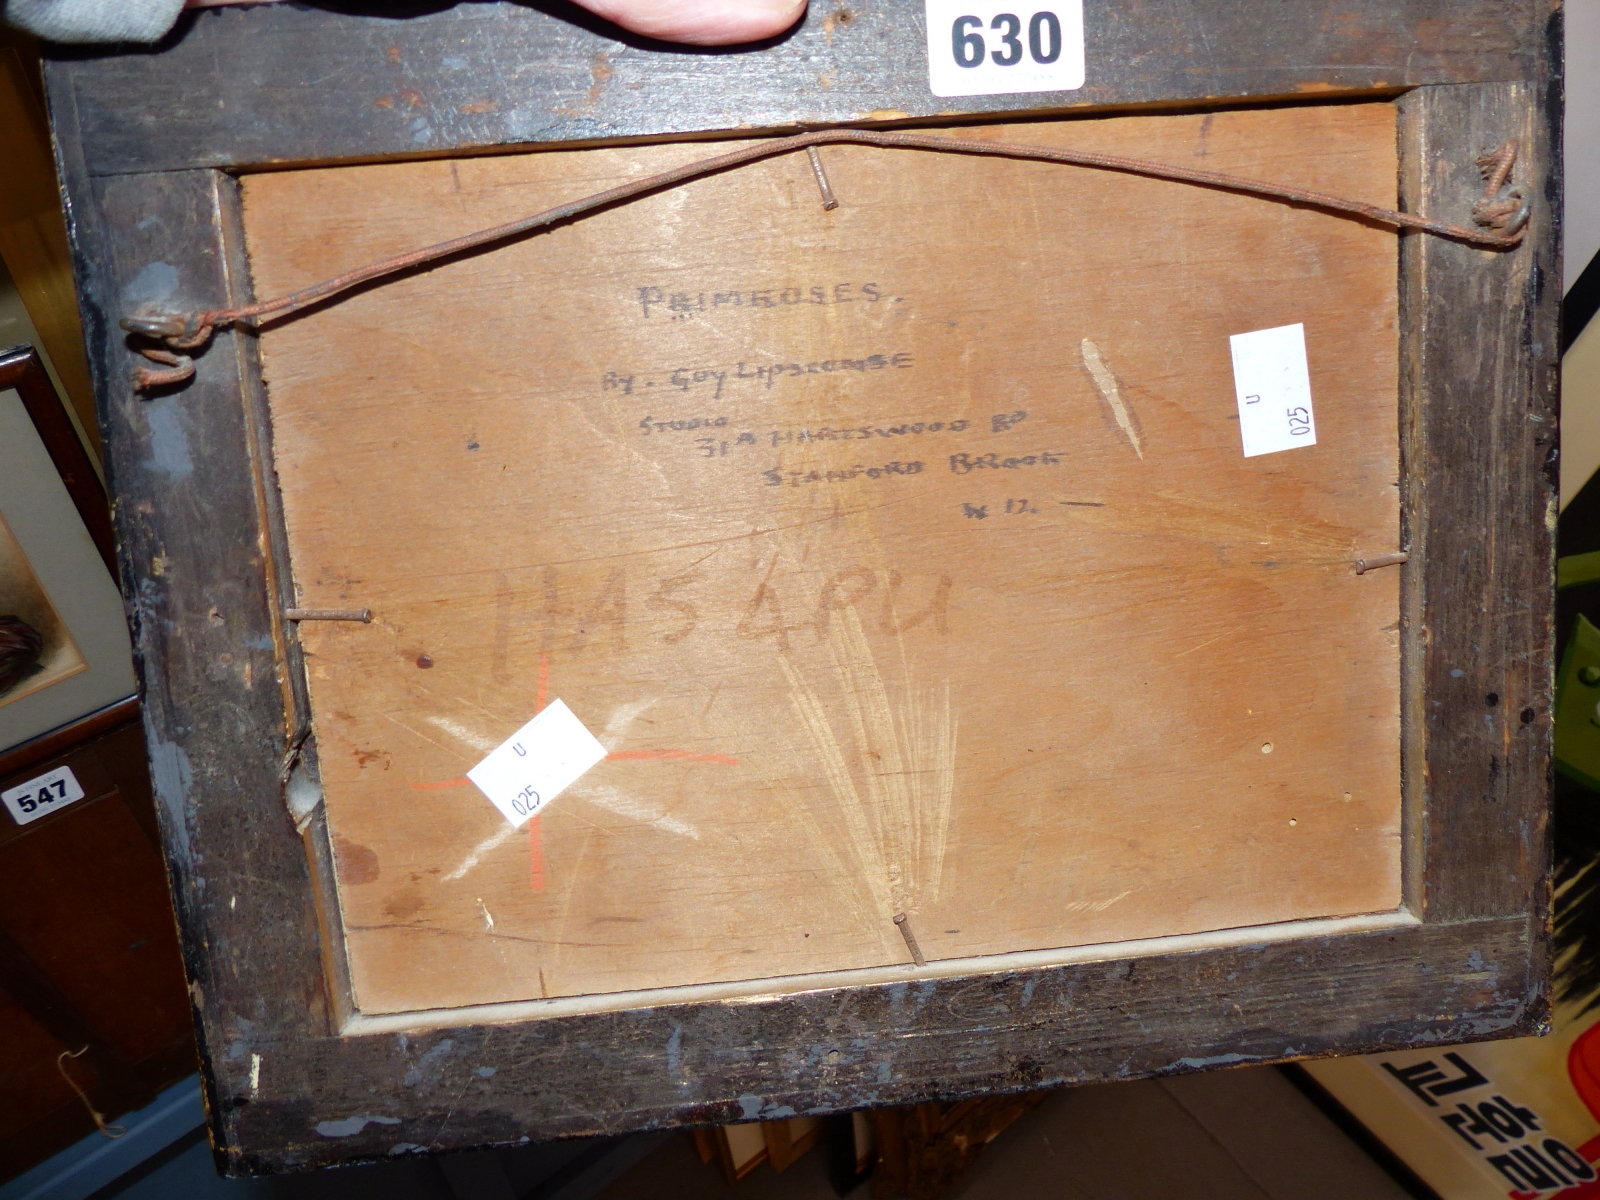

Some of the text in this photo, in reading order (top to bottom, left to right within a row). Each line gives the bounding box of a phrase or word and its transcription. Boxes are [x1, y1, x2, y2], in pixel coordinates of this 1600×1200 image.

[951, 11, 1062, 69] 630
[1286, 406, 1311, 436] 025
[513, 742, 527, 757] U
[17, 779, 67, 813] 547
[511, 784, 541, 816] 025
[1380, 1052, 1595, 1191] 교훈을
